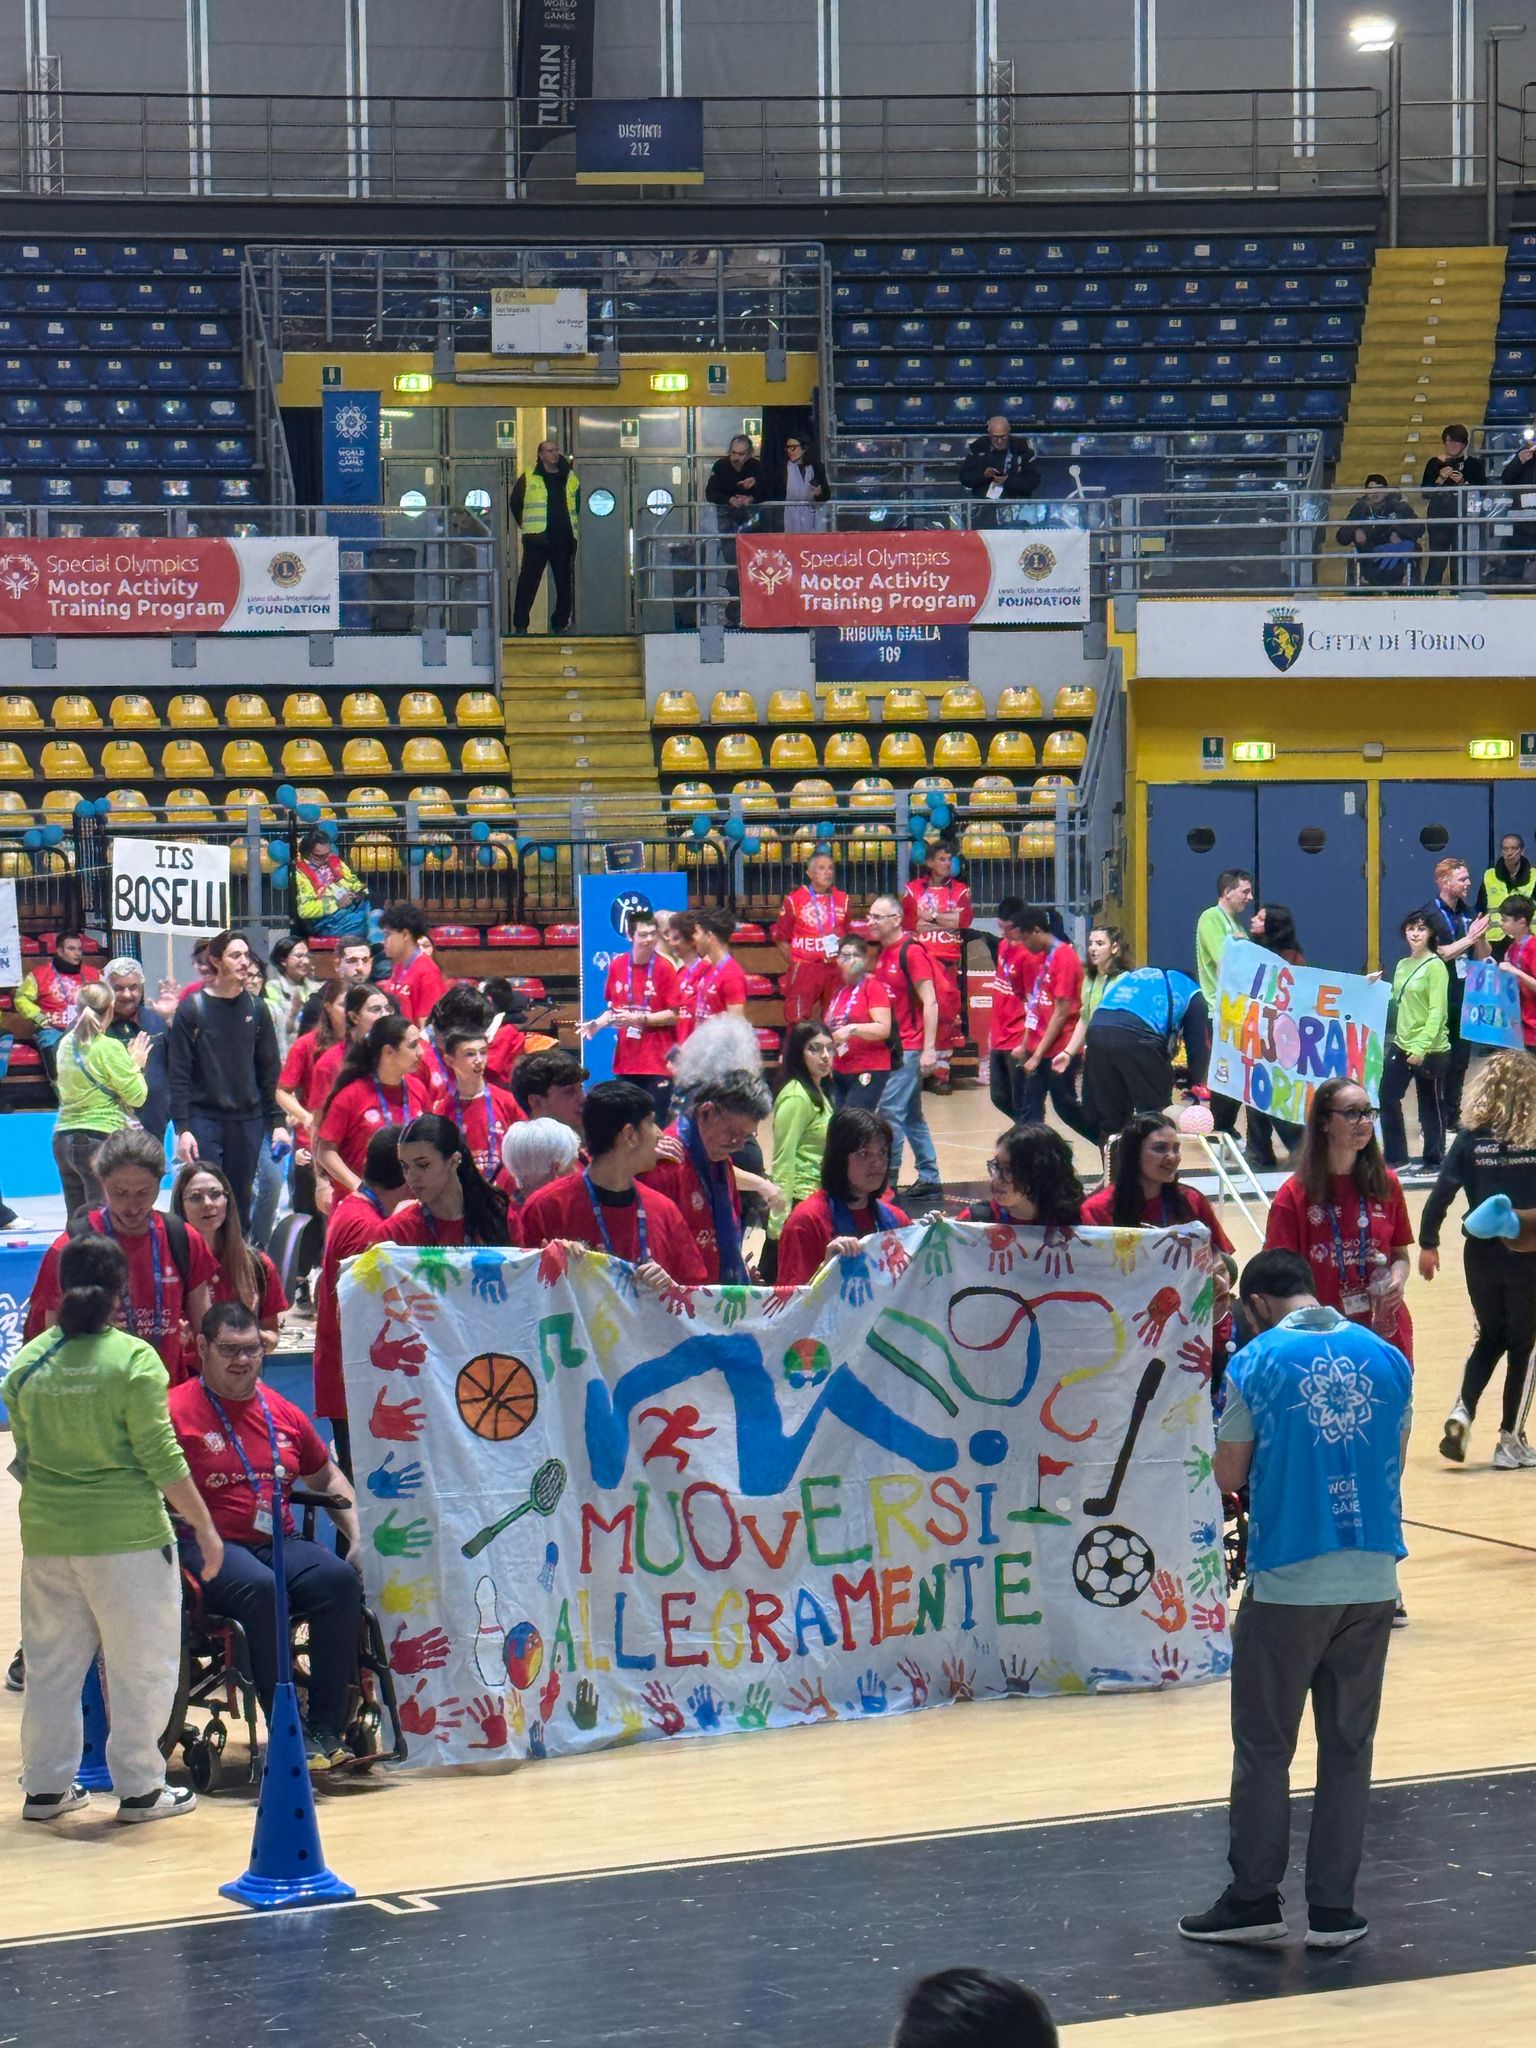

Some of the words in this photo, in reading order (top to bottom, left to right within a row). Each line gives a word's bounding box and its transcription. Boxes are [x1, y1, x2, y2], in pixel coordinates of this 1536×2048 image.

[538, 44, 561, 125] TURIN
[630, 142, 650, 156] 212
[46, 553, 110, 576] Special
[115, 554, 199, 577] Olympics
[800, 548, 863, 571] Special
[867, 548, 950, 572] Olympics
[48, 579, 112, 596] Motor
[117, 577, 199, 599] Activity
[800, 573, 864, 590] Motor
[869, 571, 950, 591] Activity
[47, 599, 131, 620] Training
[137, 599, 225, 619] Program
[247, 604, 331, 615] FOUNDATION
[800, 592, 883, 613] Training
[889, 592, 976, 612] Program
[998, 596, 1081, 607] FOUNDATION
[838, 626, 893, 642] TRIBUNA
[896, 625, 941, 641] GIALLA
[878, 646, 901, 663] 109
[154, 845, 194, 870] IIS
[114, 873, 227, 929] BOSELLI
[1219, 992, 1384, 1090] MAJORANA
[579, 1474, 1000, 1576] MUOVERSI
[550, 1550, 1043, 1672] ALLEGRAMENTE
